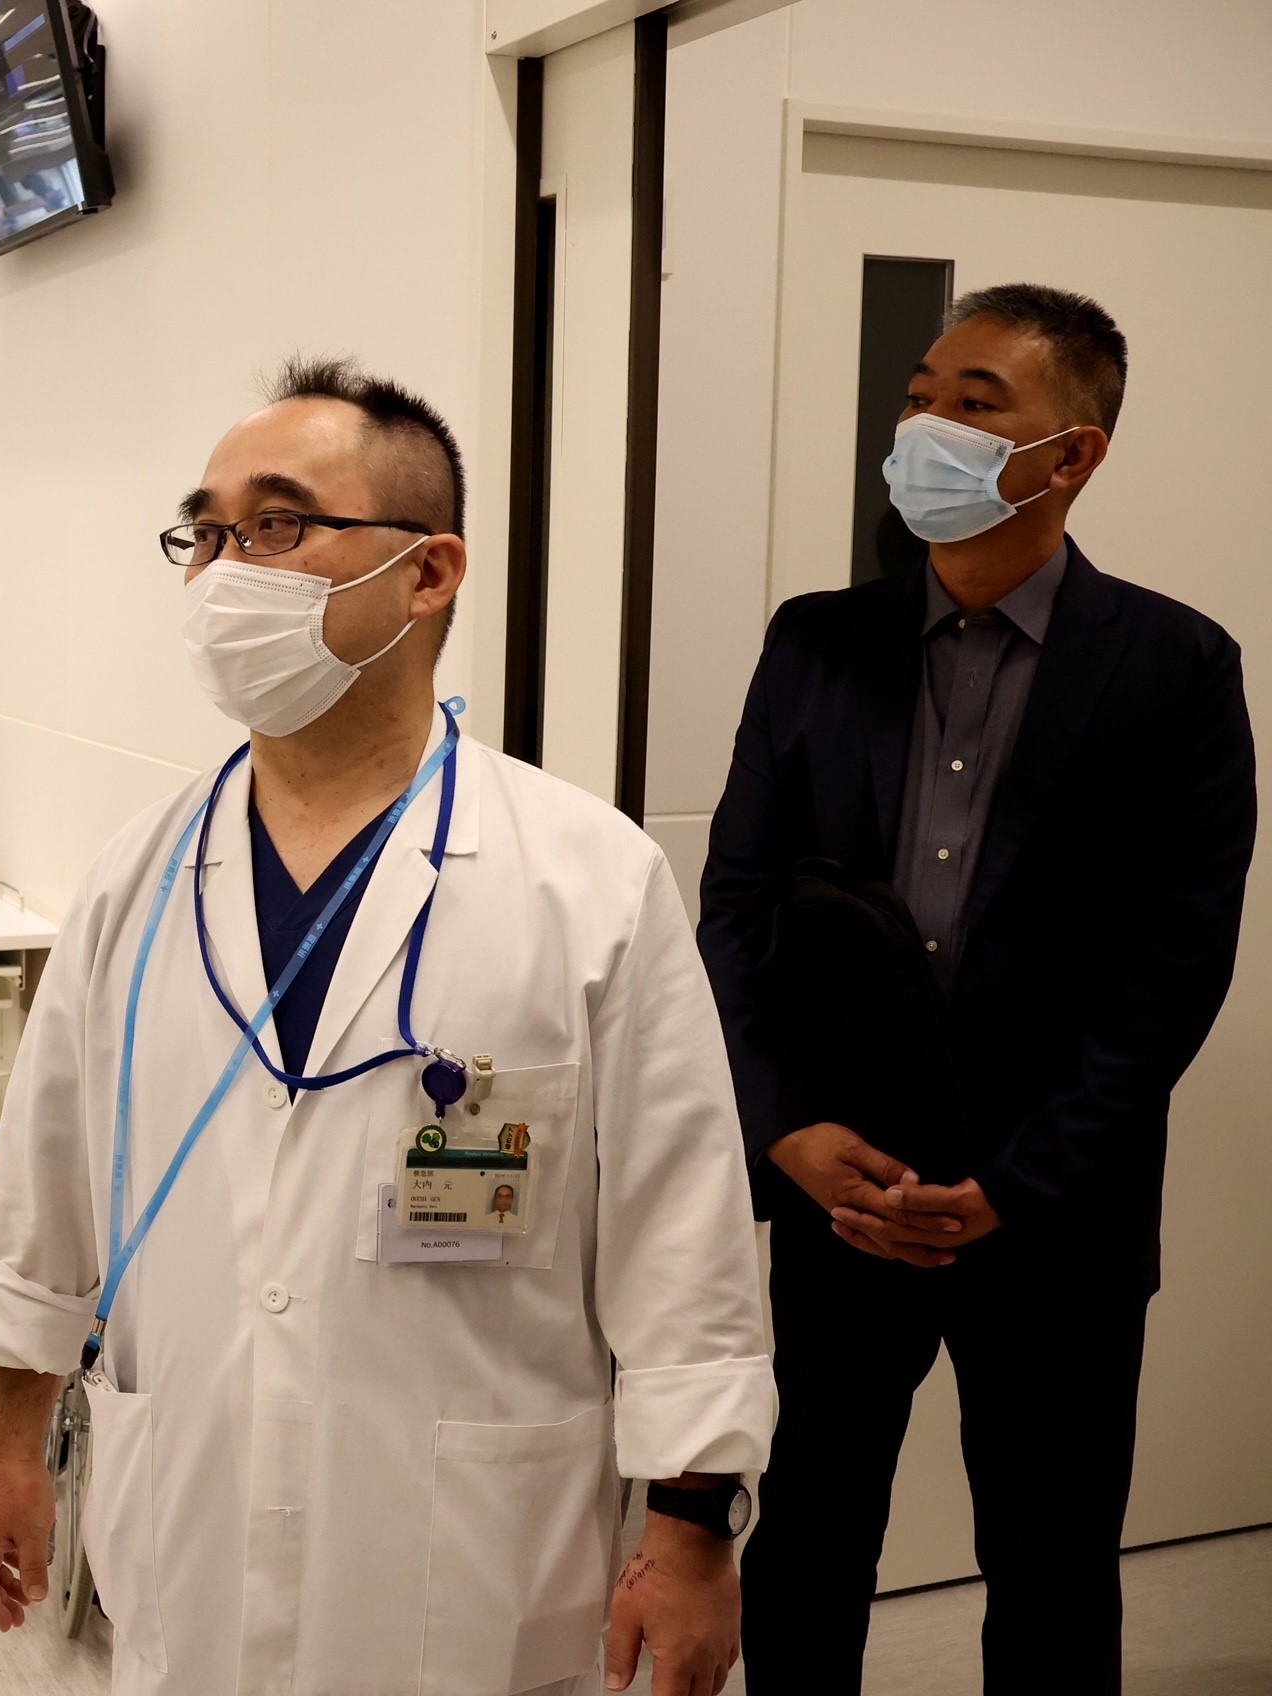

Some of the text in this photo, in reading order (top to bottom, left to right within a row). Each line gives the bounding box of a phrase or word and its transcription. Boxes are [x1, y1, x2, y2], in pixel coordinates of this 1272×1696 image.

[413, 1179, 454, 1190] 大内 元
[421, 1240, 461, 1249] No.A00076
